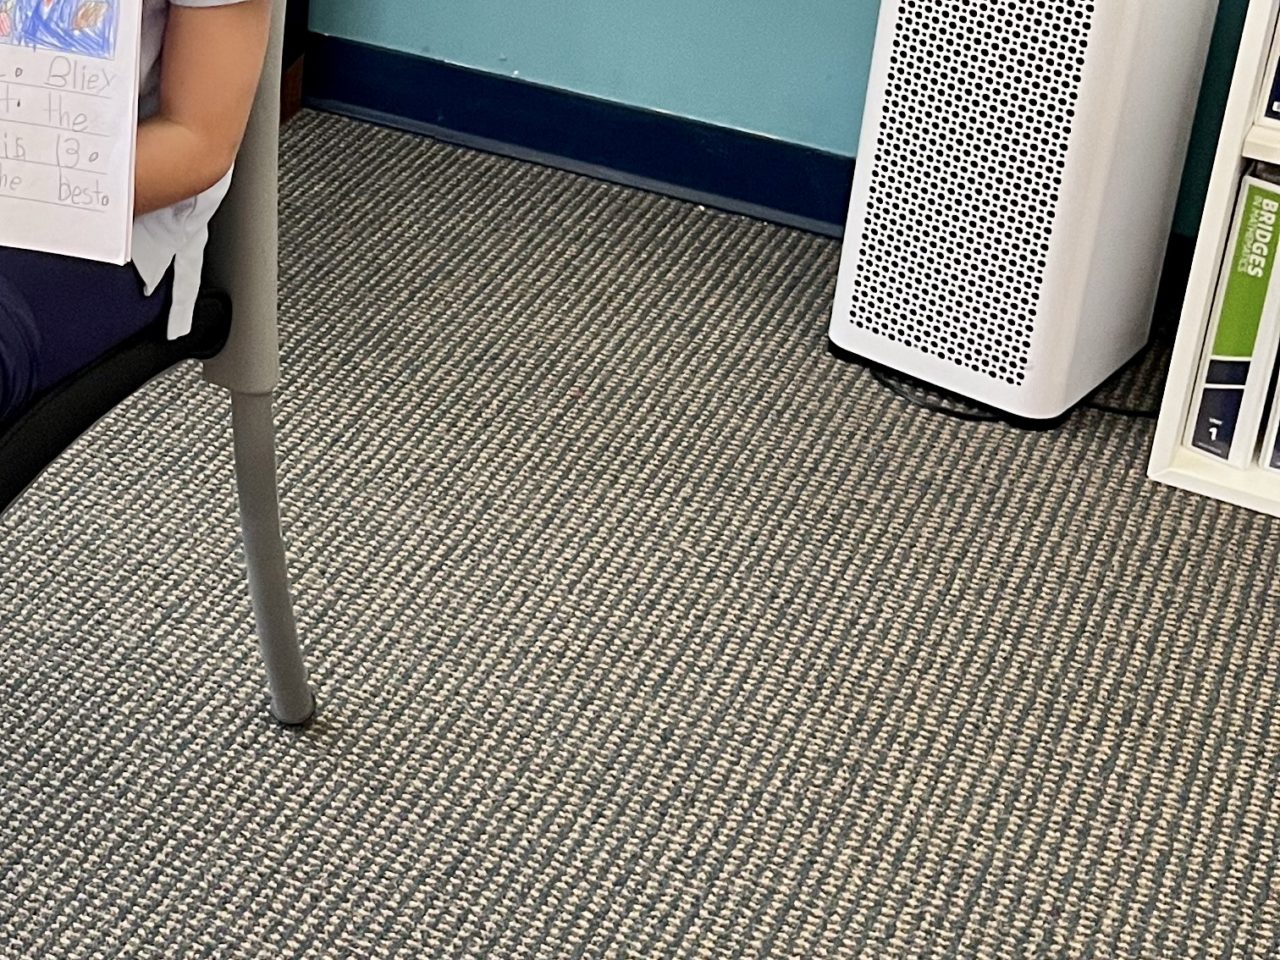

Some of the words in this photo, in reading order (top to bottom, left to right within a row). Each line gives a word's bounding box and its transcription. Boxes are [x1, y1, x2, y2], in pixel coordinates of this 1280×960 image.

[43, 91, 89, 133] the
[1247, 198, 1279, 278] BRIDGES
[1208, 427, 1218, 441] 1
